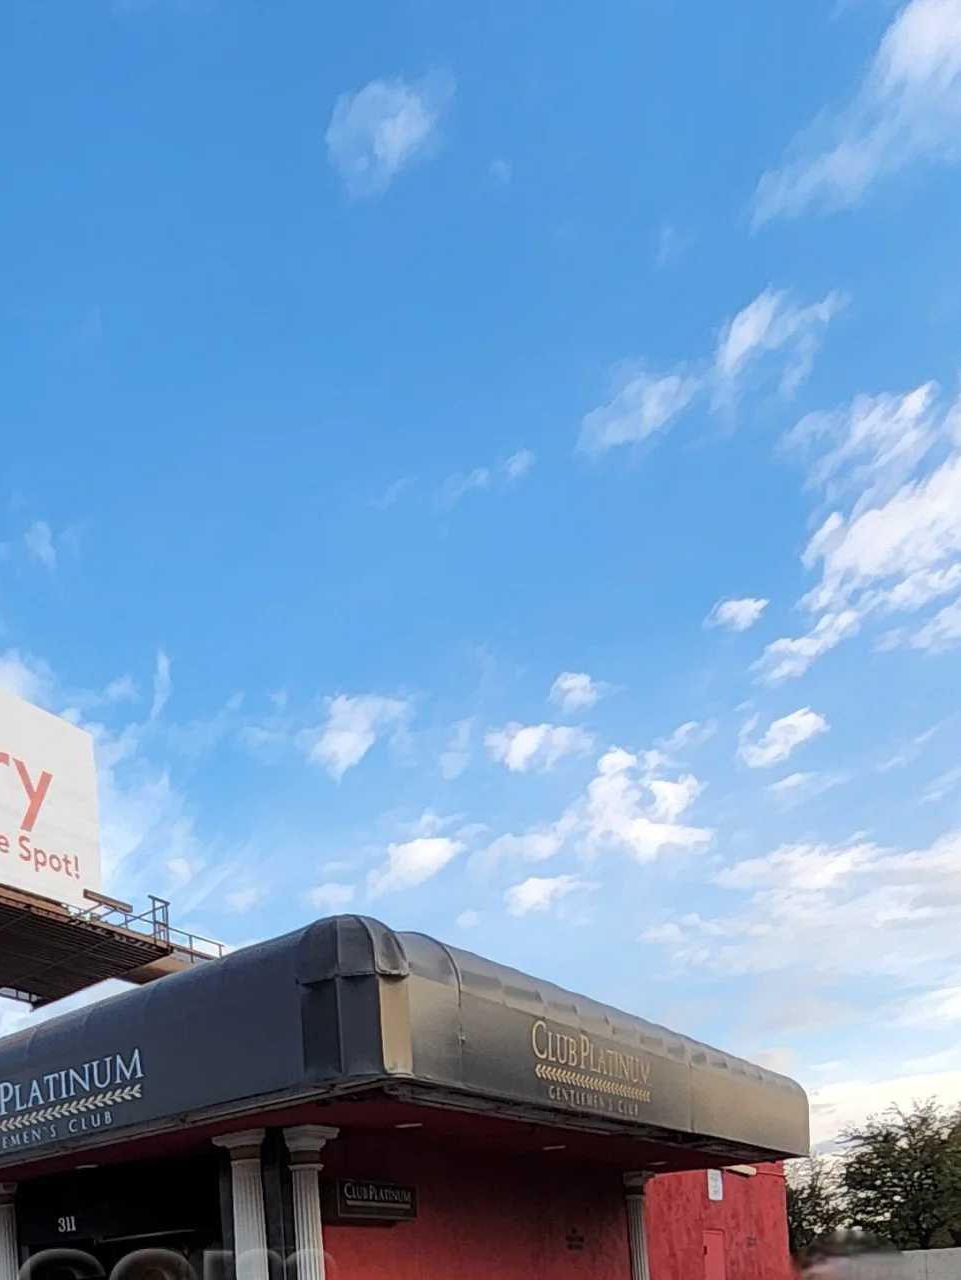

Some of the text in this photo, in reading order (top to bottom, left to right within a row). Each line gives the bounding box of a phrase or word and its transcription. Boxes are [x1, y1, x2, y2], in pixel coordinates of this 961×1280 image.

[19, 836, 81, 880] Spot!
[532, 1020, 578, 1067] CLUB
[68, 1111, 113, 1133] CLUB
[344, 1182, 369, 1200] CLUB
[58, 1215, 77, 1233] 311
